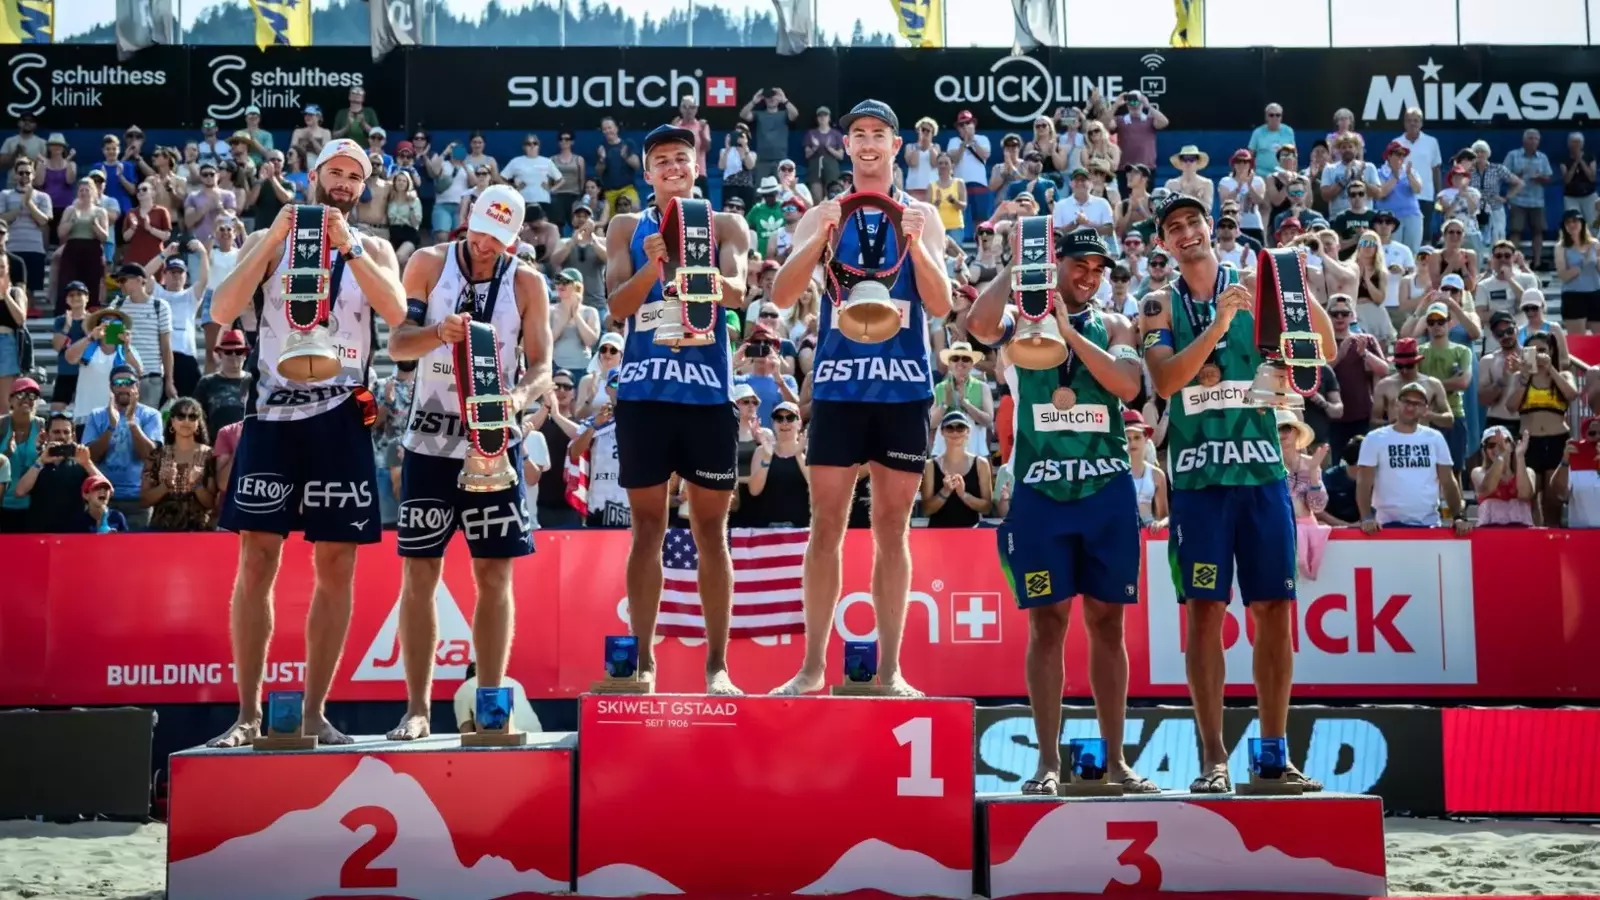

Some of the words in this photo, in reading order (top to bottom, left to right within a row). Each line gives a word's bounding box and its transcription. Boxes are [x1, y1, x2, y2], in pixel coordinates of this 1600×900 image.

[51, 65, 166, 86] schulthess
[251, 67, 363, 87] schulthess
[1148, 81, 1159, 89] TV
[52, 88, 102, 108] klinik
[507, 69, 700, 108] swatch
[251, 90, 301, 110] klinik
[619, 358, 722, 389] GSTAAD
[814, 357, 927, 382] GSTAAD
[1189, 387, 1243, 406] swatch
[1040, 411, 1095, 424] swatch
[1176, 440, 1280, 473] GSTAAD
[1388, 444, 1430, 457] BEACH
[1389, 456, 1431, 469] GSTAAD
[107, 663, 222, 685] BUILDING
[230, 661, 306, 683] TUST
[597, 701, 667, 714] SKIWELT
[671, 702, 737, 716] GSTAAD
[645, 719, 664, 728] SEIT
[667, 719, 689, 728] 1906
[892, 717, 944, 797] 1
[339, 805, 398, 888] 2
[1103, 821, 1162, 892] 3
